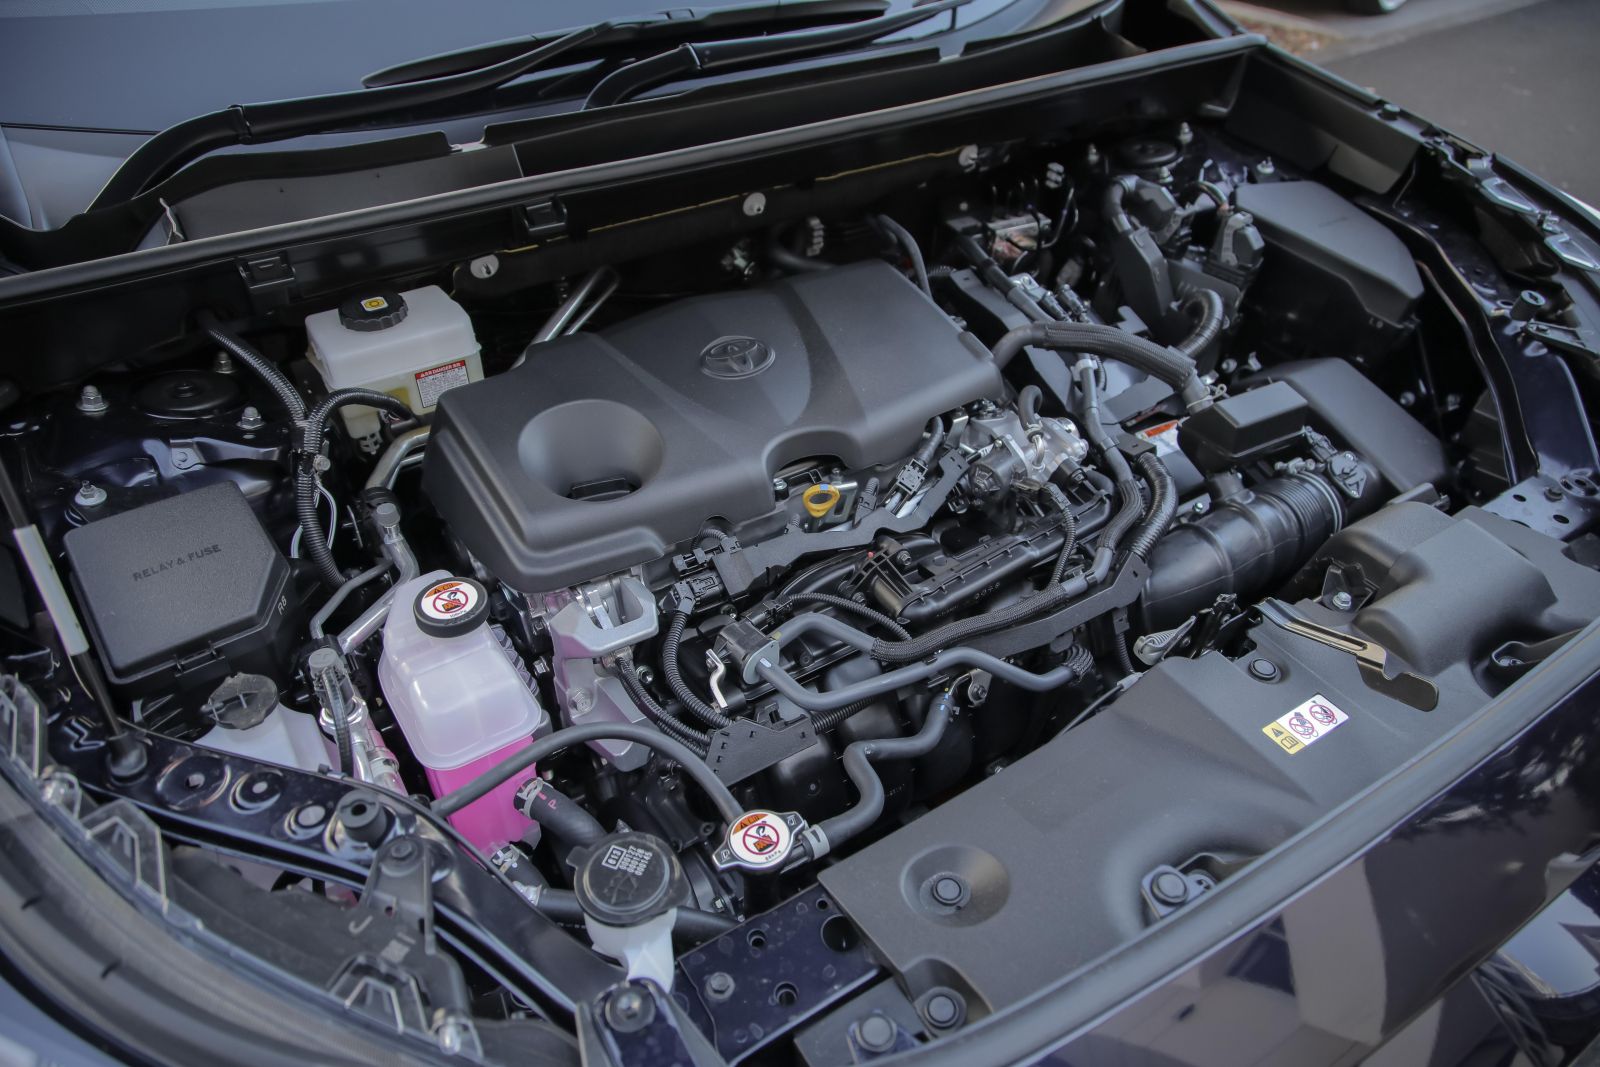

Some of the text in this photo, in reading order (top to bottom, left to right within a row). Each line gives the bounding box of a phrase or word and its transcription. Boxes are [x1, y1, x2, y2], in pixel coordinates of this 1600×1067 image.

[132, 544, 222, 581] RELAY & FUSE
